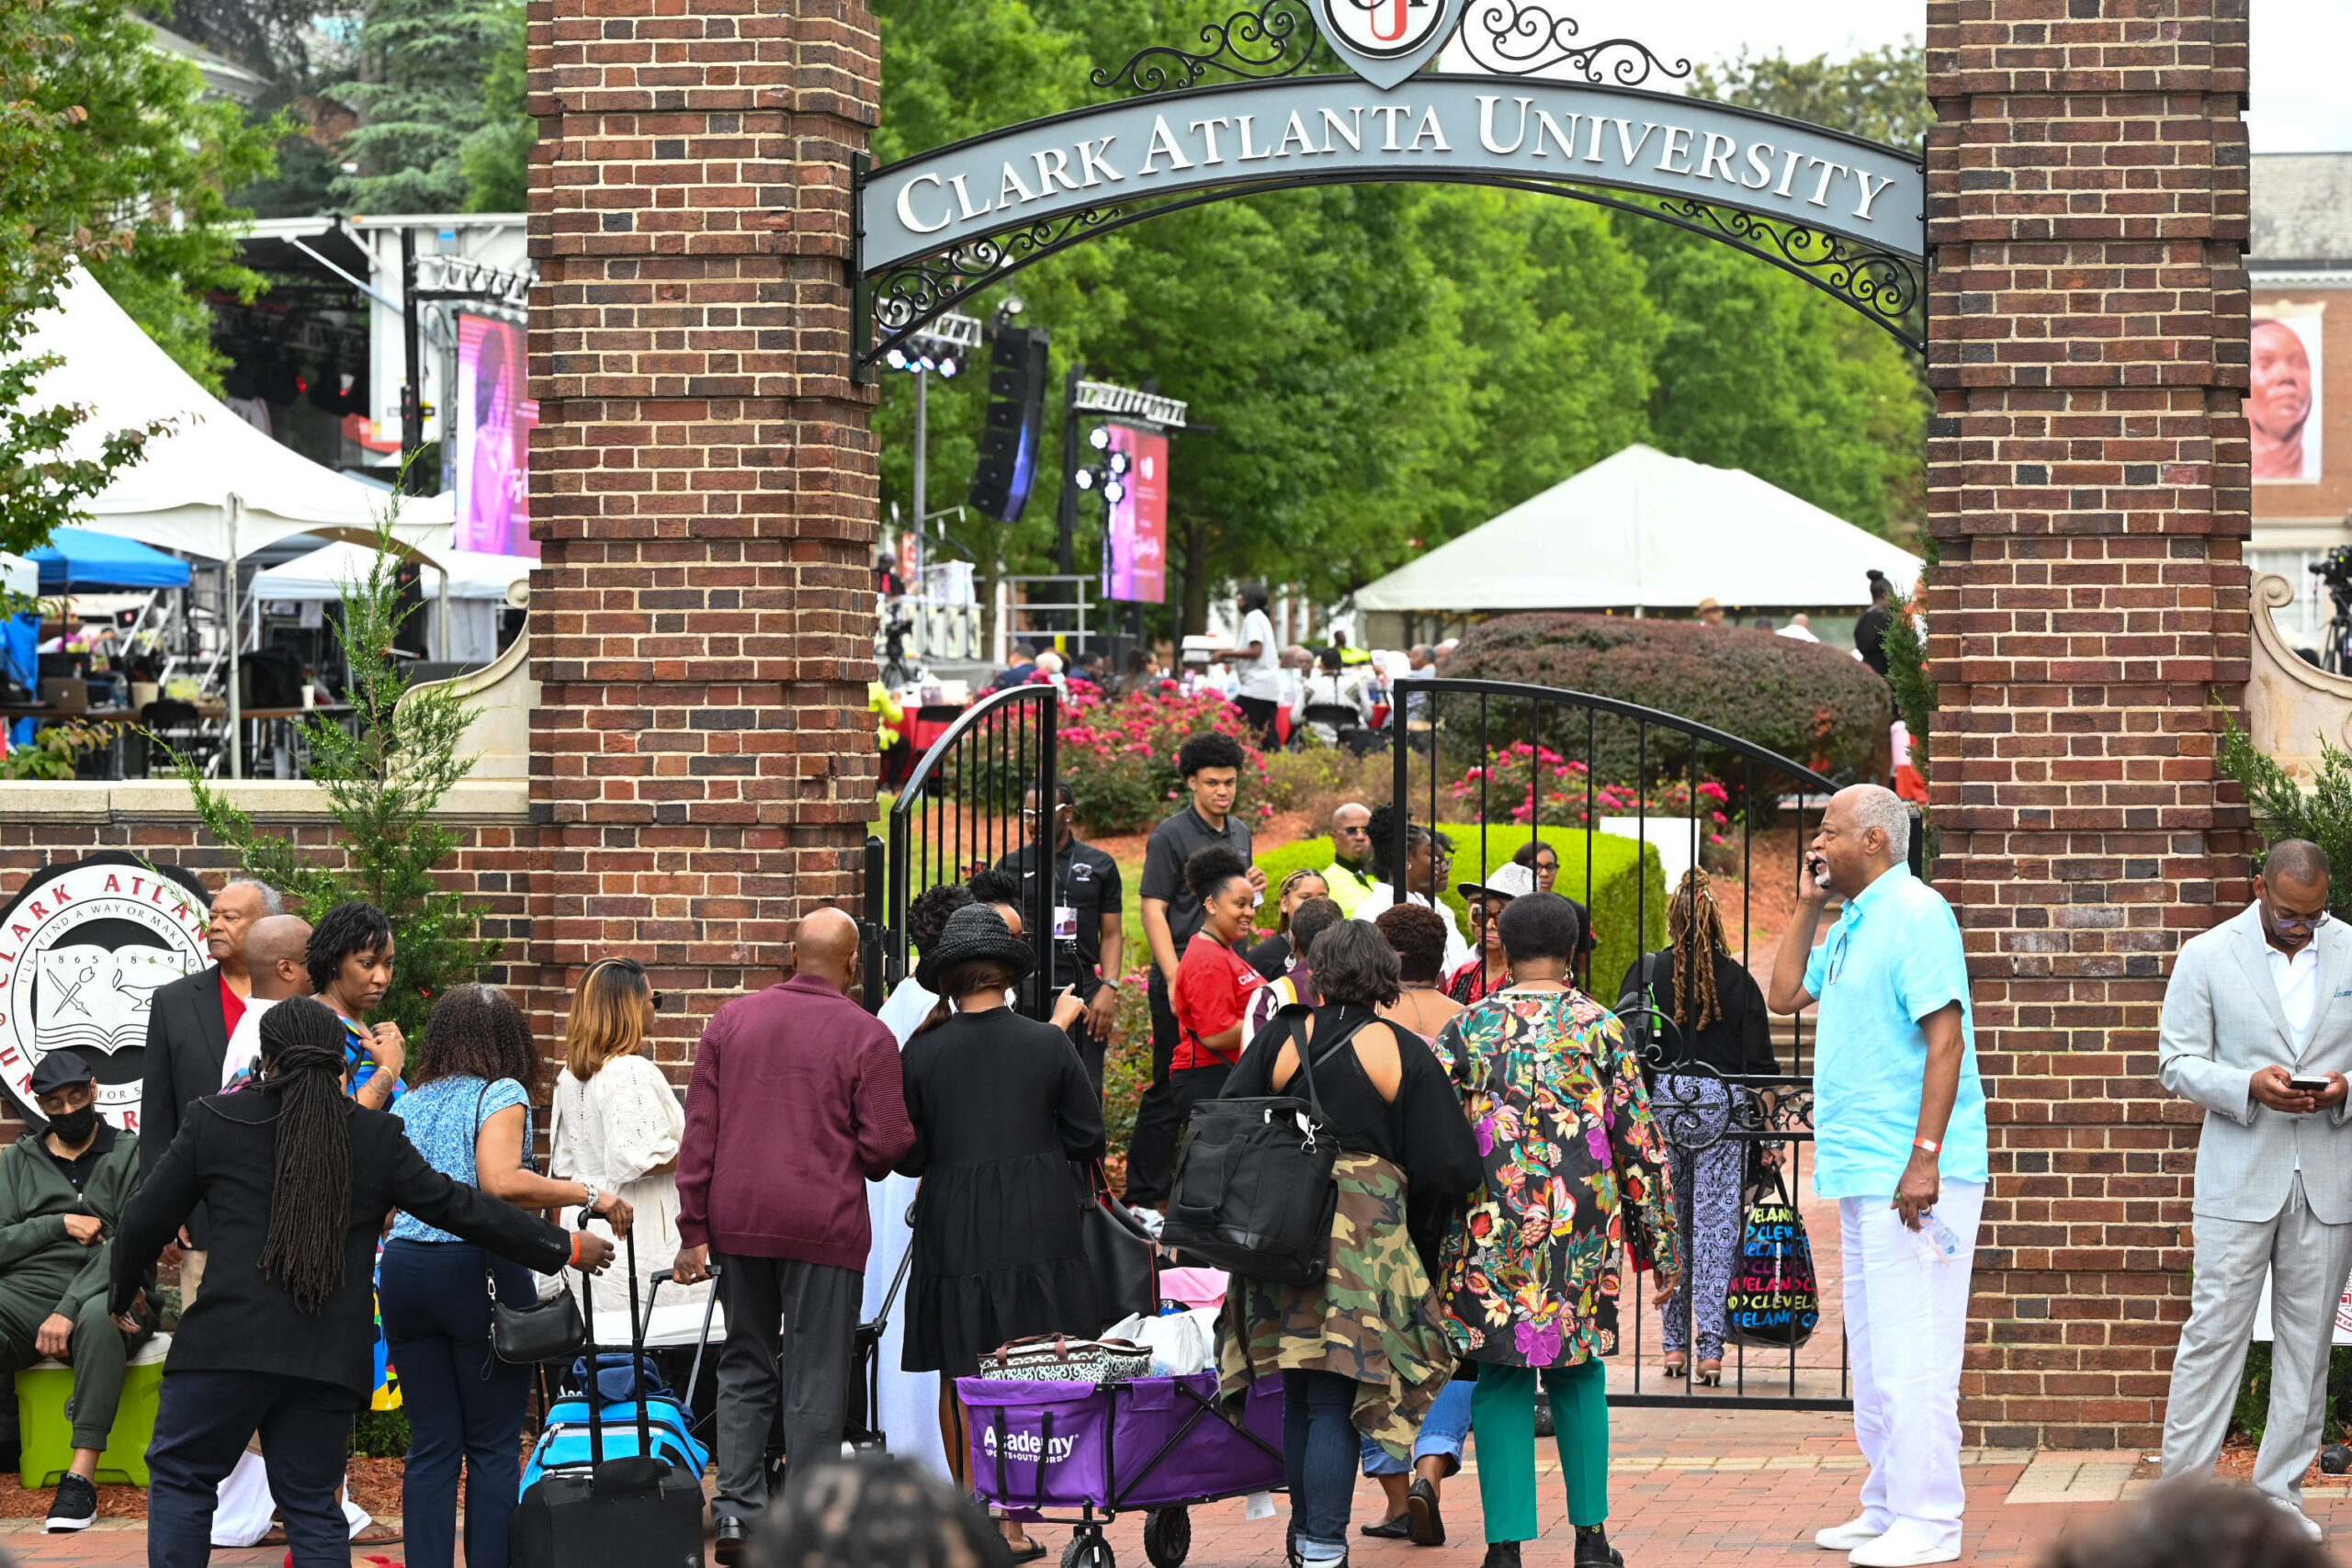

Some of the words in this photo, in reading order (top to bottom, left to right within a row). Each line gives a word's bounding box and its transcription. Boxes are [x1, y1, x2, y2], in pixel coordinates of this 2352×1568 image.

[896, 135, 1124, 235] CLARK
[1138, 106, 1453, 175] ATLANTA
[1474, 96, 1895, 220] UNIVERSITY
[39, 917, 70, 947] FIND
[76, 910, 84, 919] A
[91, 904, 120, 914] WAY
[127, 907, 144, 919] OR
[151, 917, 185, 949] MAKE
[104, 874, 213, 960] ATLAN
[98, 1089, 127, 1100] FOR
[984, 1426, 1073, 1459] Aademy
